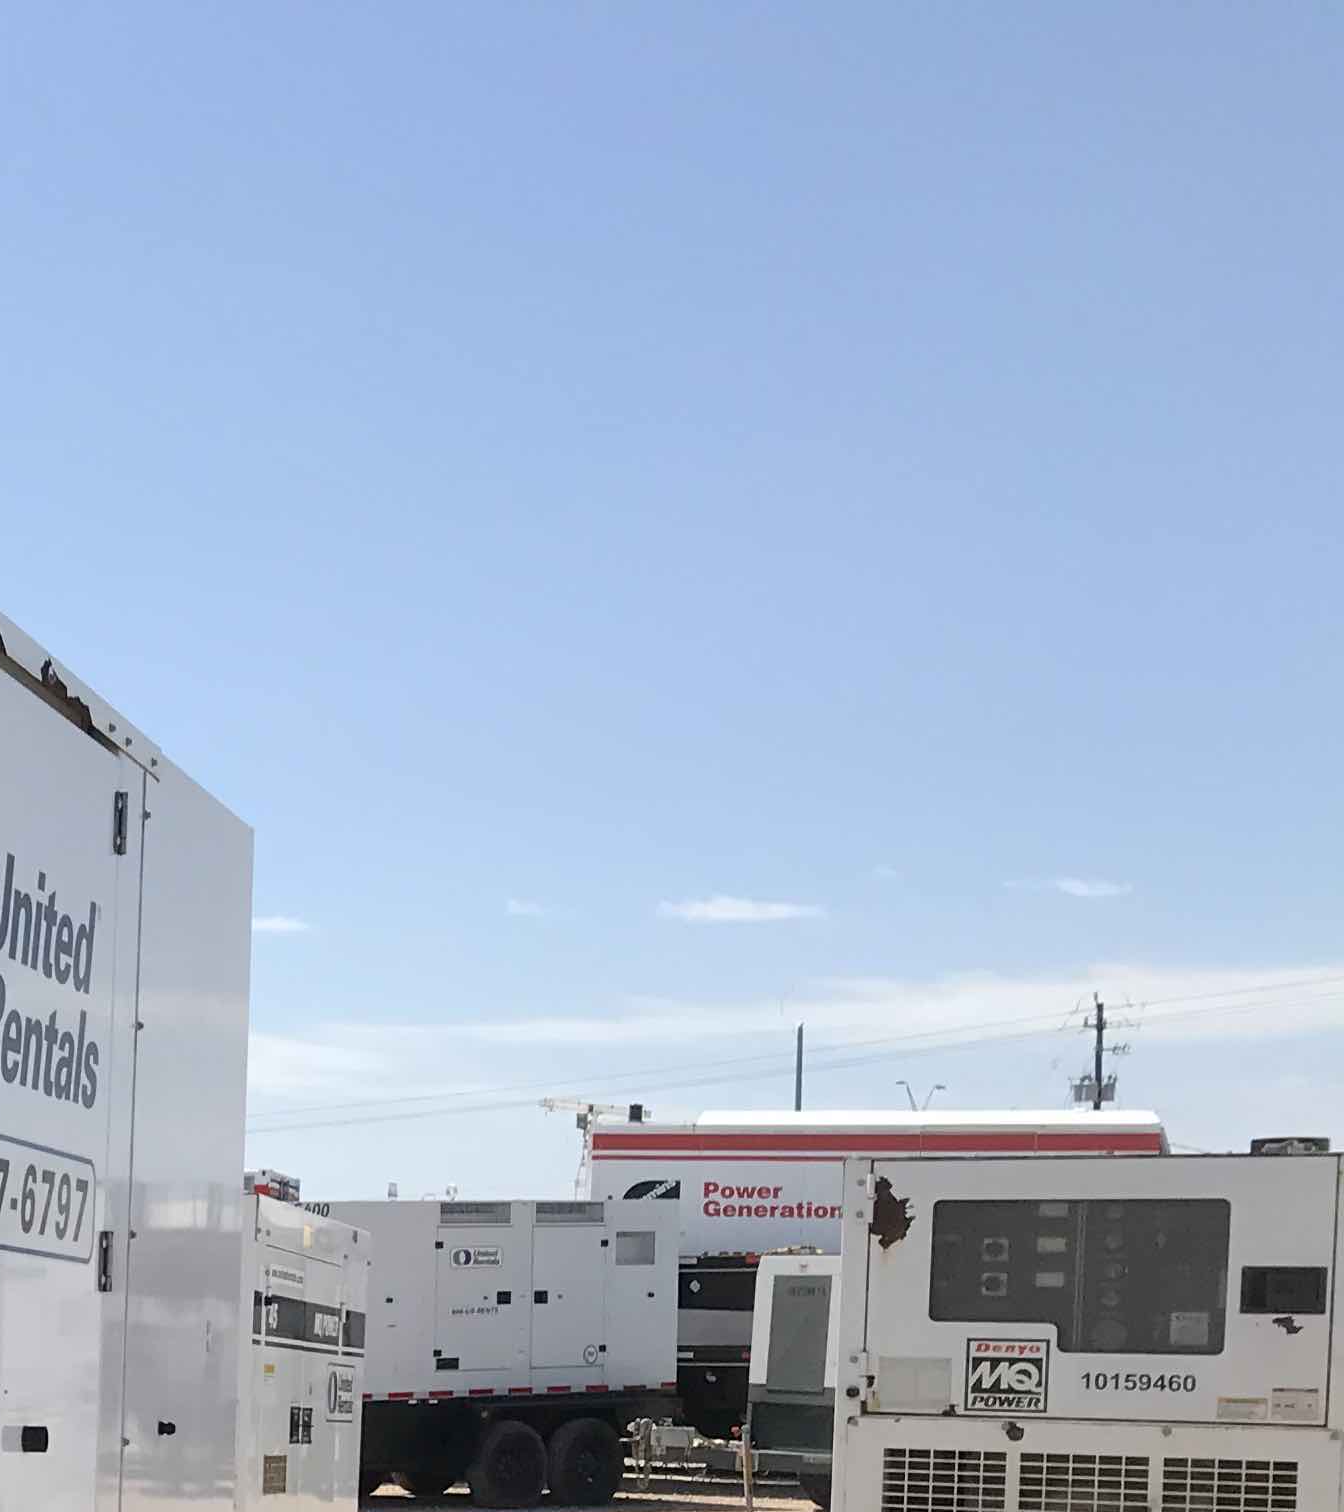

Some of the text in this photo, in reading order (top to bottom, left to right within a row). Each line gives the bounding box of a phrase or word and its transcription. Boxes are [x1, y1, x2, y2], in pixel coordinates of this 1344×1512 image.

[704, 1182, 783, 1199] Power
[703, 1200, 843, 1219] Generation
[975, 1342, 1041, 1357] Denyo
[970, 1361, 1044, 1391] MQ
[1081, 1372, 1197, 1393] 10159460
[970, 1395, 1041, 1409] POWER
